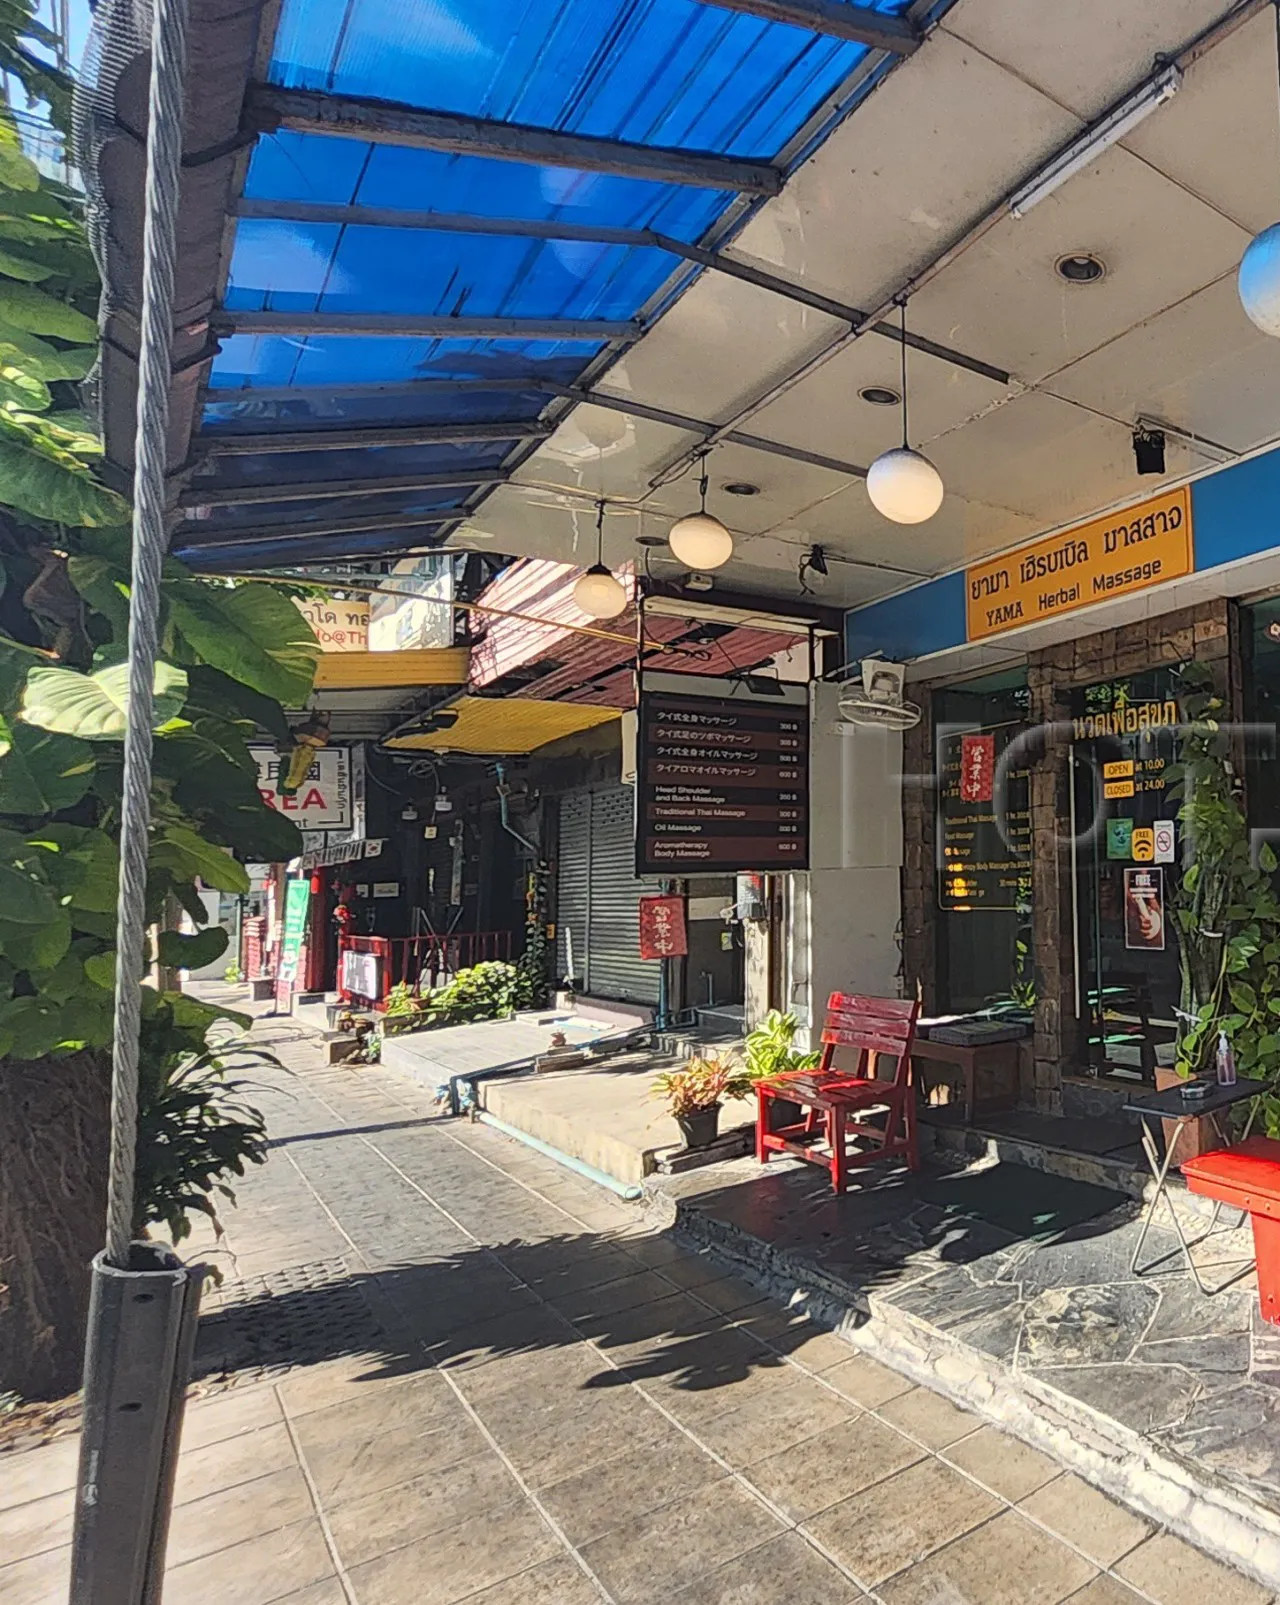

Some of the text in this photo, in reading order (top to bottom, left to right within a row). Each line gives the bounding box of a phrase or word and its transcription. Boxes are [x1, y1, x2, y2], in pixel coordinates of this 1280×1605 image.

[971, 569, 1010, 600] ยามา
[1104, 505, 1182, 555] มาสสาจ
[986, 558, 1162, 627] YAMA Herbal Massage
[1072, 697, 1177, 743] นวดเพื่อสุขภ
[1108, 758, 1165, 775] OPEN at 10.00
[678, 786, 711, 794] Shoulder
[1106, 779, 1165, 796] CLOSED at 24.00
[692, 795, 726, 804] Massage
[655, 808, 746, 817] Traditional Thai Massage
[667, 824, 702, 833] Massage
[1135, 830, 1149, 838] FREE
[654, 841, 708, 849] Aromatherapy
[654, 850, 711, 858] Body Massage
